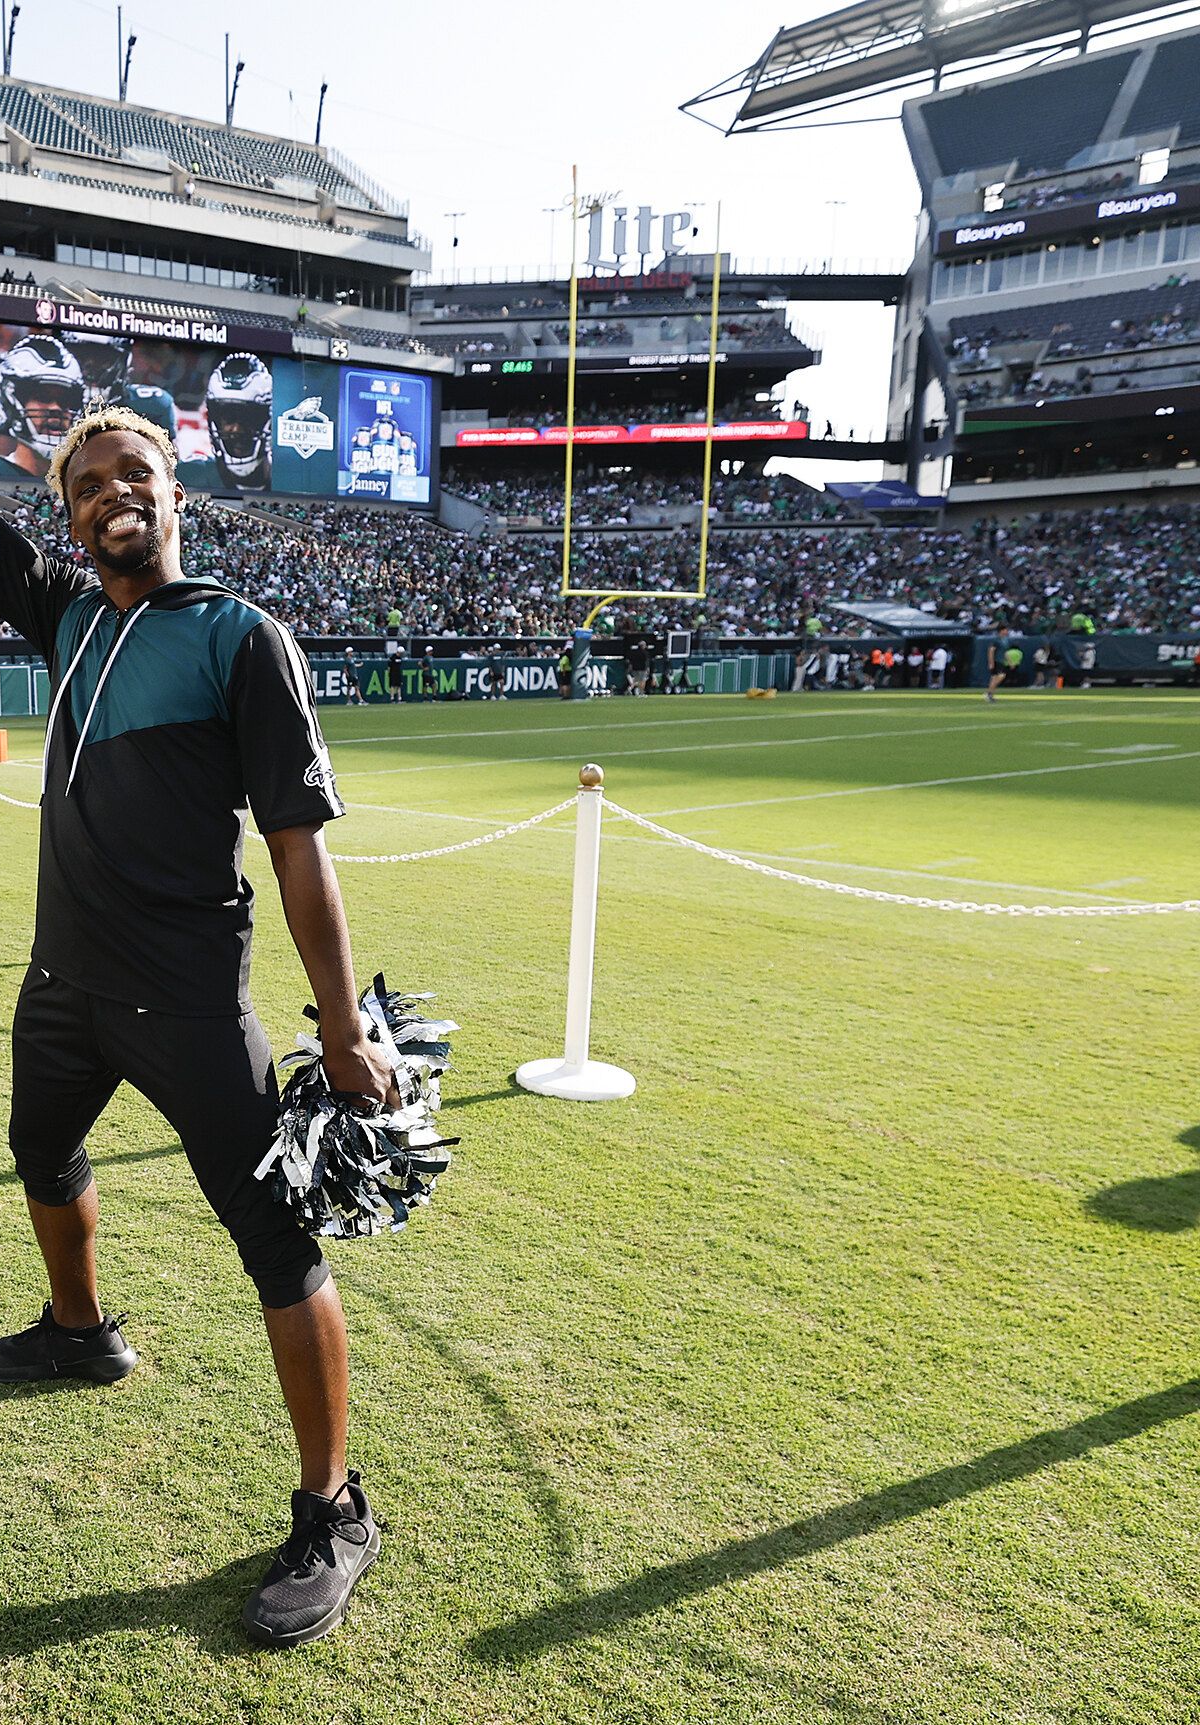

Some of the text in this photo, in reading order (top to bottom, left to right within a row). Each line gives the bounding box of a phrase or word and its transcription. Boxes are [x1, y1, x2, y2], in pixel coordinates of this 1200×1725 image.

[1097, 191, 1177, 219] Nouryon
[584, 206, 691, 271] Lite
[955, 219, 1026, 245] Nouryon
[642, 271, 693, 289] DECK
[60, 305, 228, 344] Lincoln Financial Field
[281, 421, 328, 435] TRAINING
[281, 431, 308, 442] CAMP
[348, 474, 389, 497] Janney
